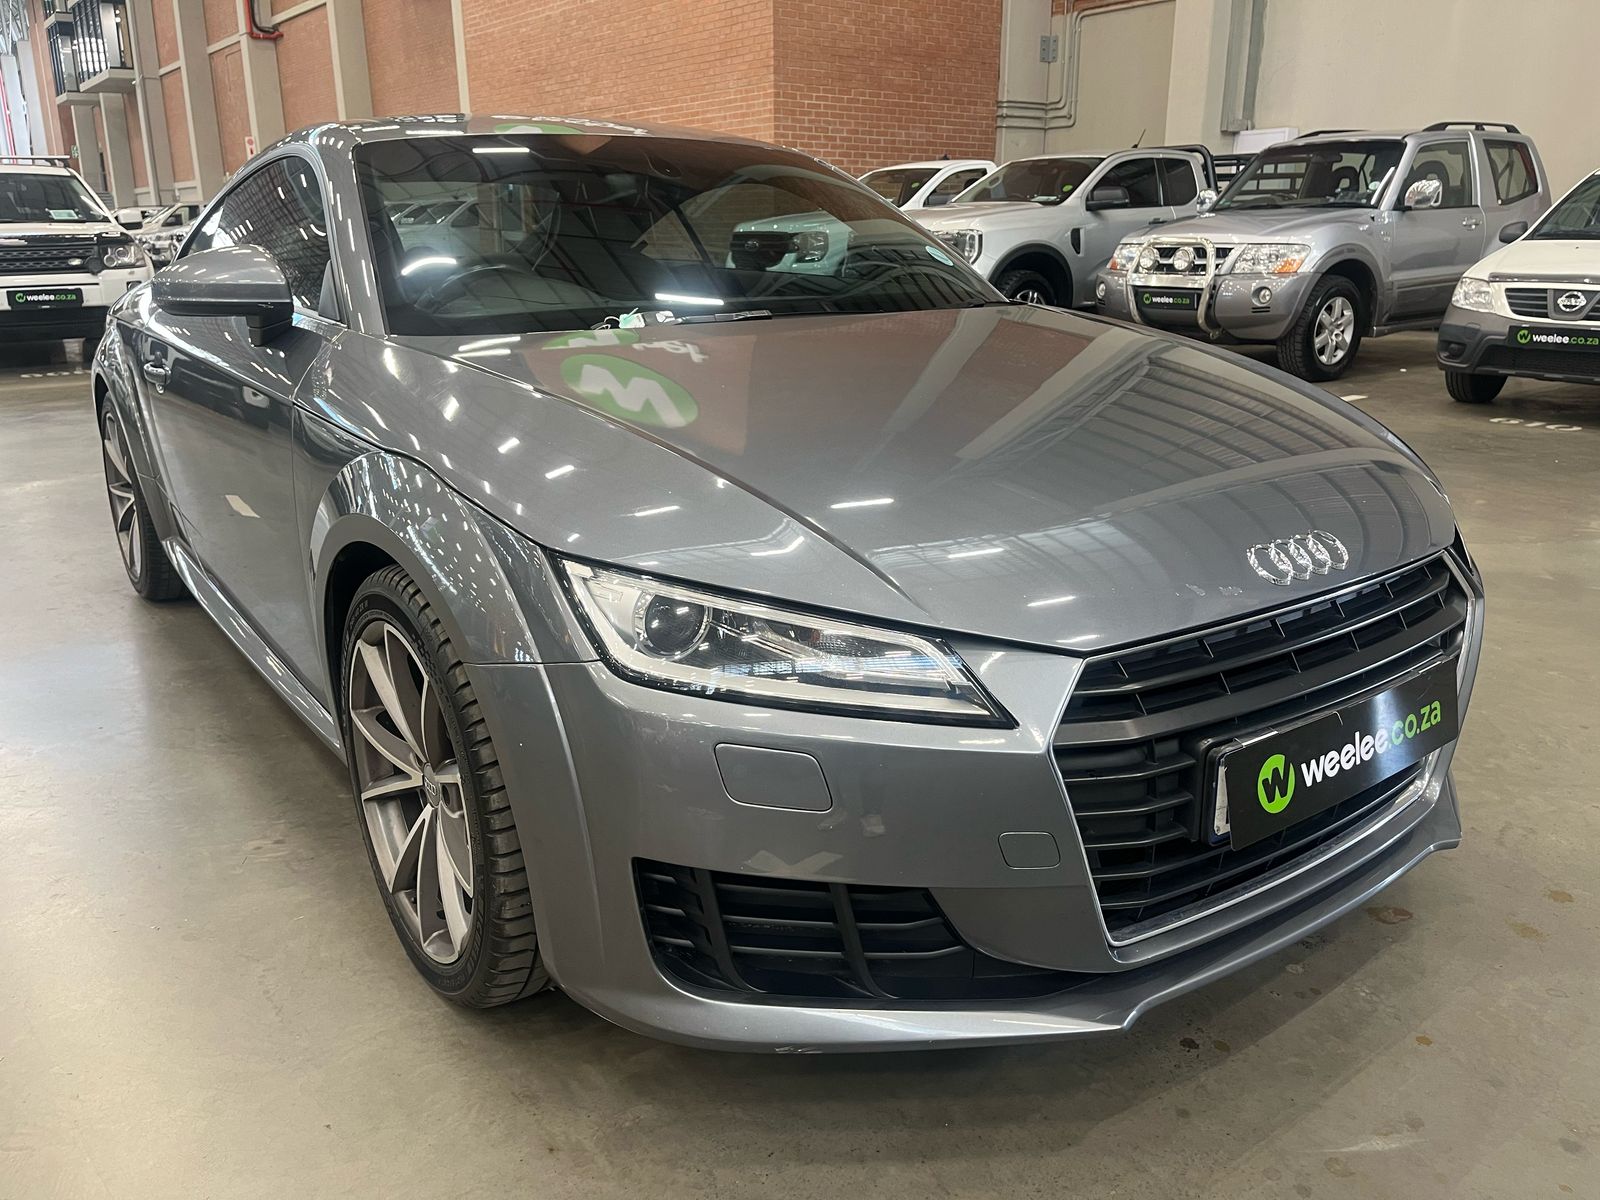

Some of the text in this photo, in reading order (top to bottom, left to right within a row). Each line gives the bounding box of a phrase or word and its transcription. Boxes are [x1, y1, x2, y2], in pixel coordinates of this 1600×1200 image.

[26, 293, 77, 302] weelee.co.za
[1532, 333, 1599, 345] weelee.co.za
[1300, 700, 1441, 788] weelee.co.za
